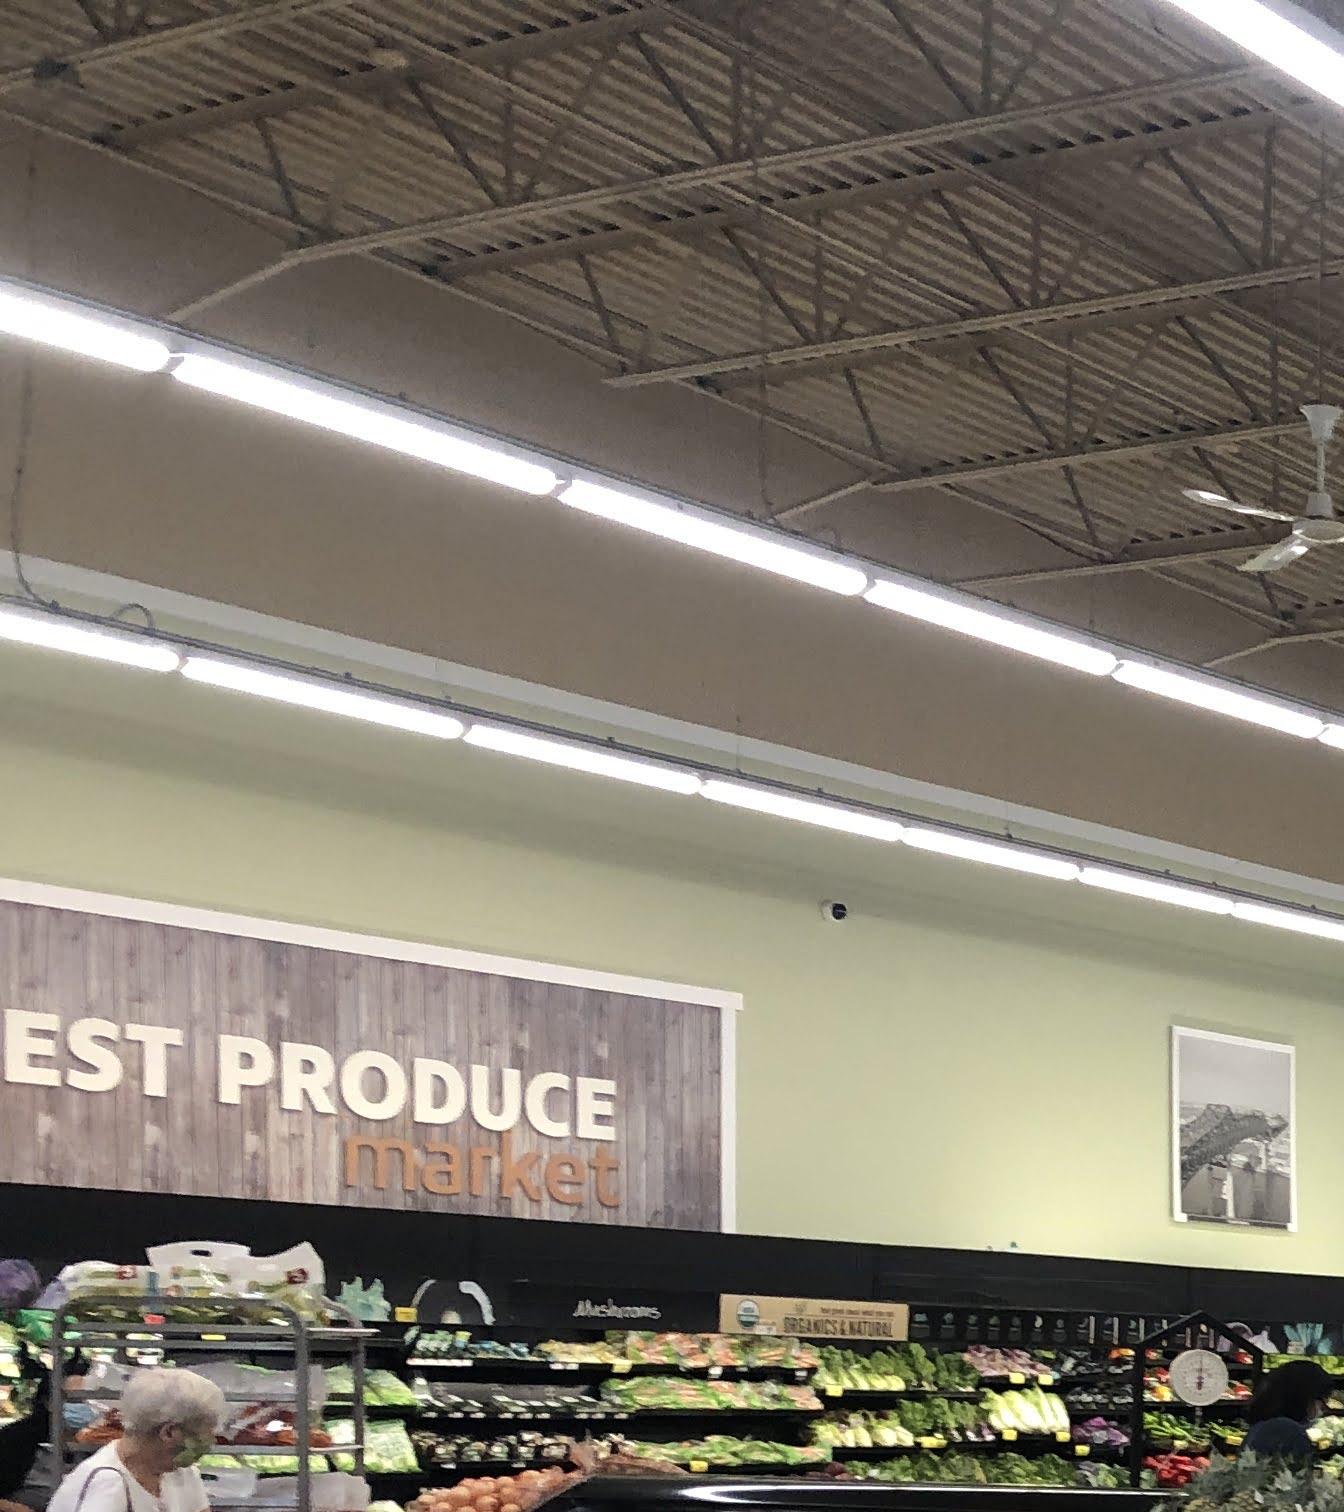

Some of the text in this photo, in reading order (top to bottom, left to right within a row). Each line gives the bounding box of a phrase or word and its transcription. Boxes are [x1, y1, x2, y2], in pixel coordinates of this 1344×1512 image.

[218, 1034, 619, 1141] PRODUCE
[342, 1130, 622, 1209] market
[783, 1316, 837, 1335] ORGANICS
[849, 1319, 894, 1338] NATURAL
